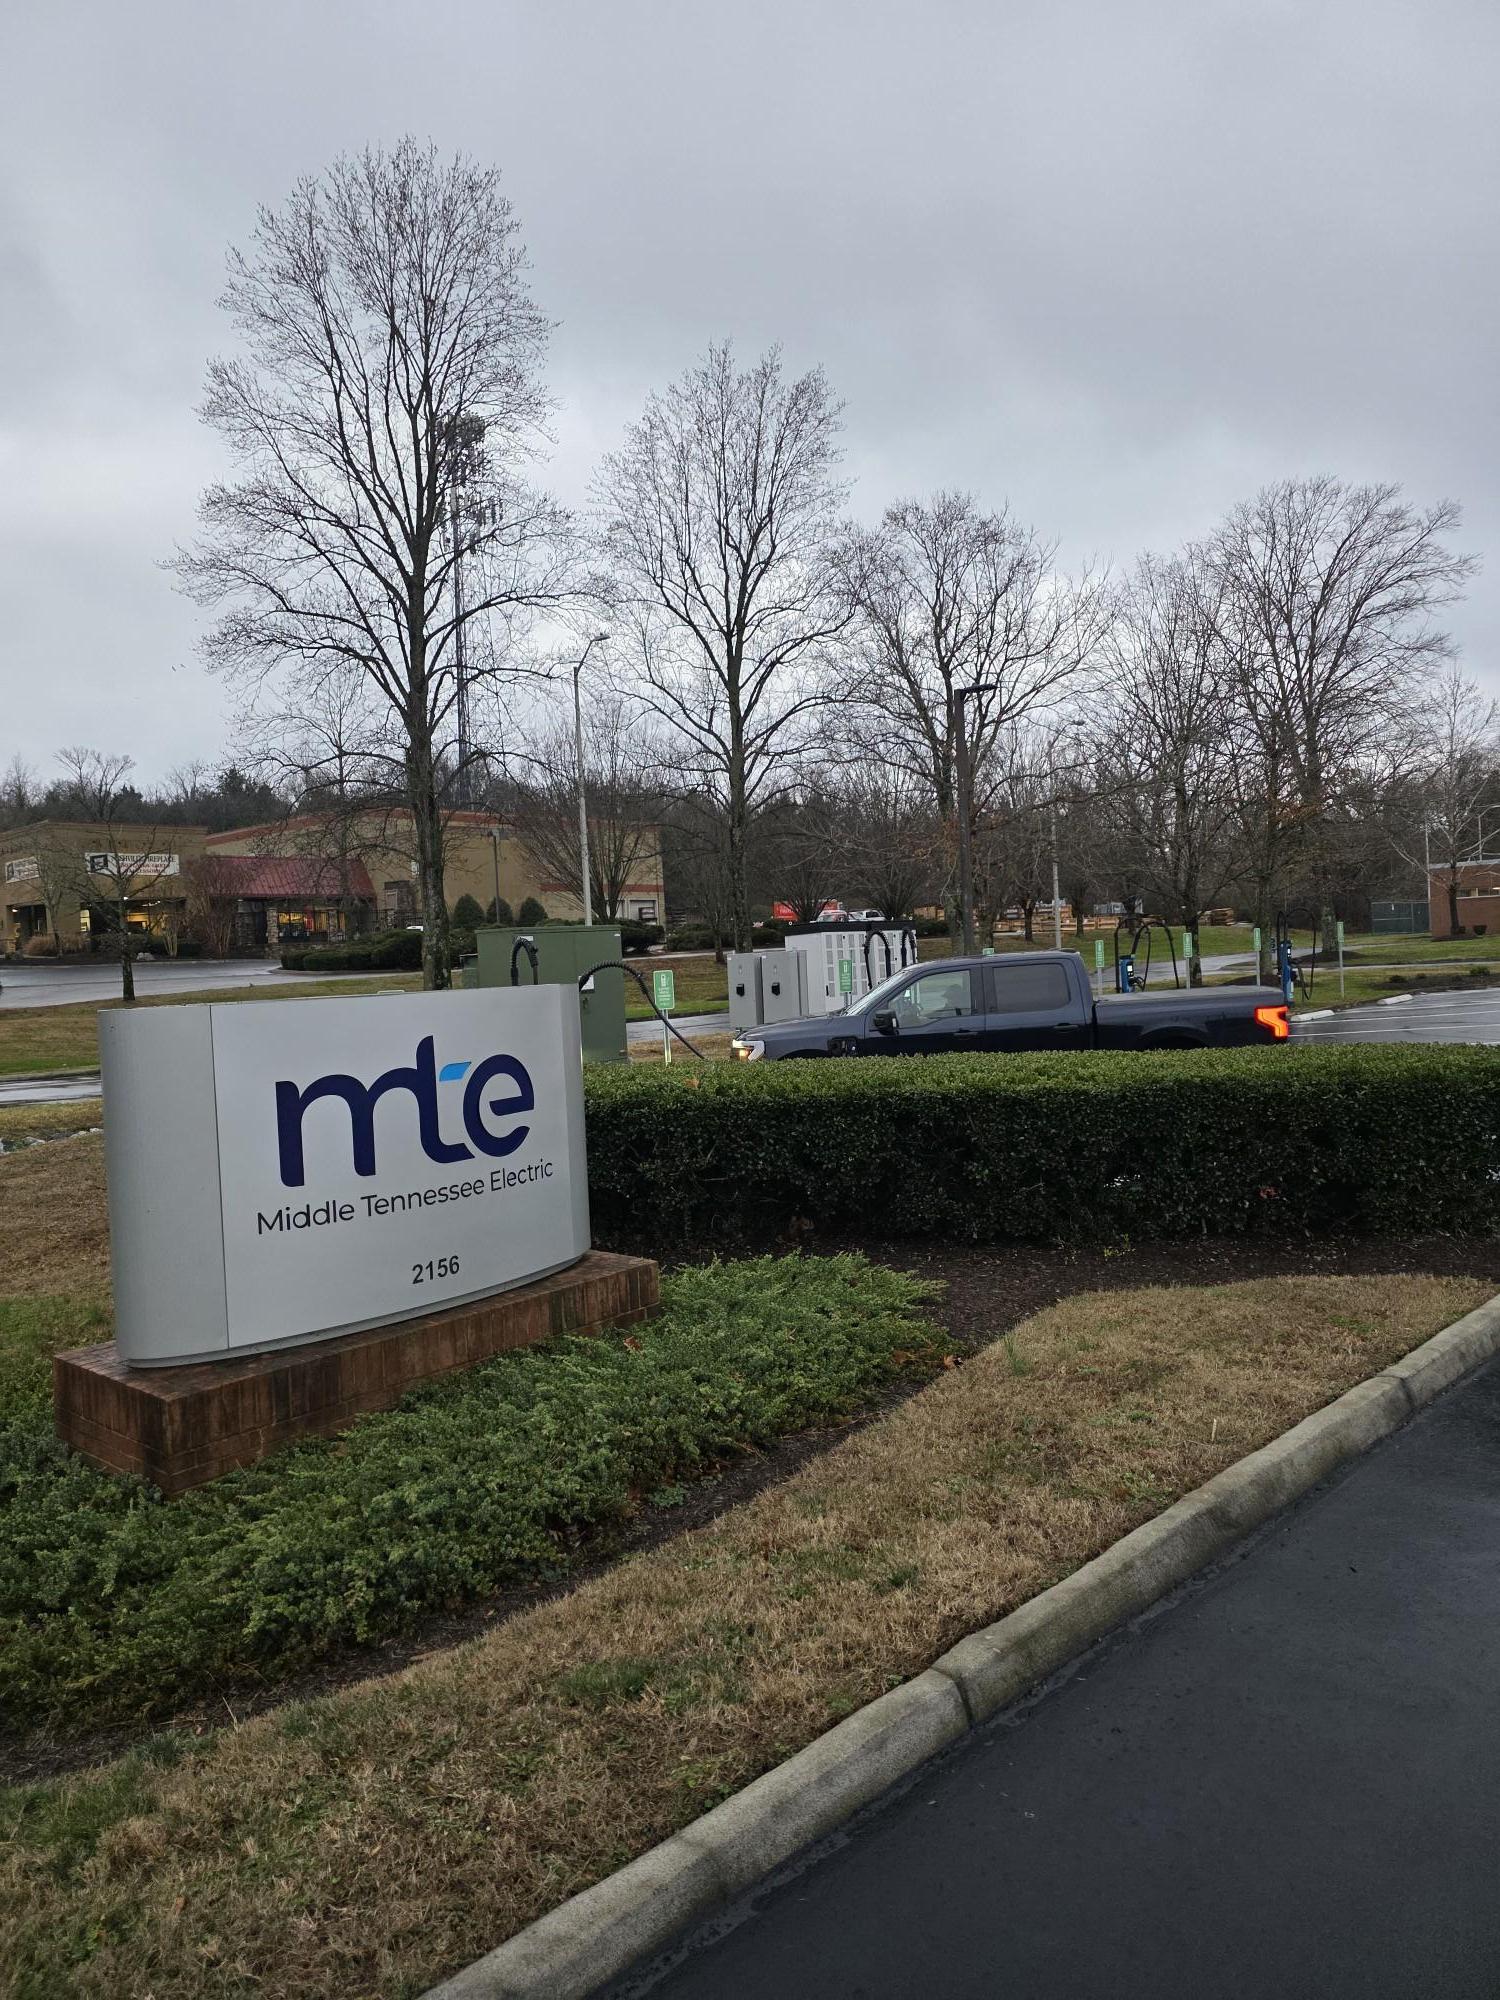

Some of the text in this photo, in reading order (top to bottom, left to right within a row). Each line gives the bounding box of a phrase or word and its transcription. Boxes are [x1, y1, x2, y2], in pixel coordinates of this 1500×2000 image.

[275, 1035, 535, 1187] mte
[257, 1158, 554, 1235] Middle Tennessee Electric
[412, 1255, 460, 1284] 2156
